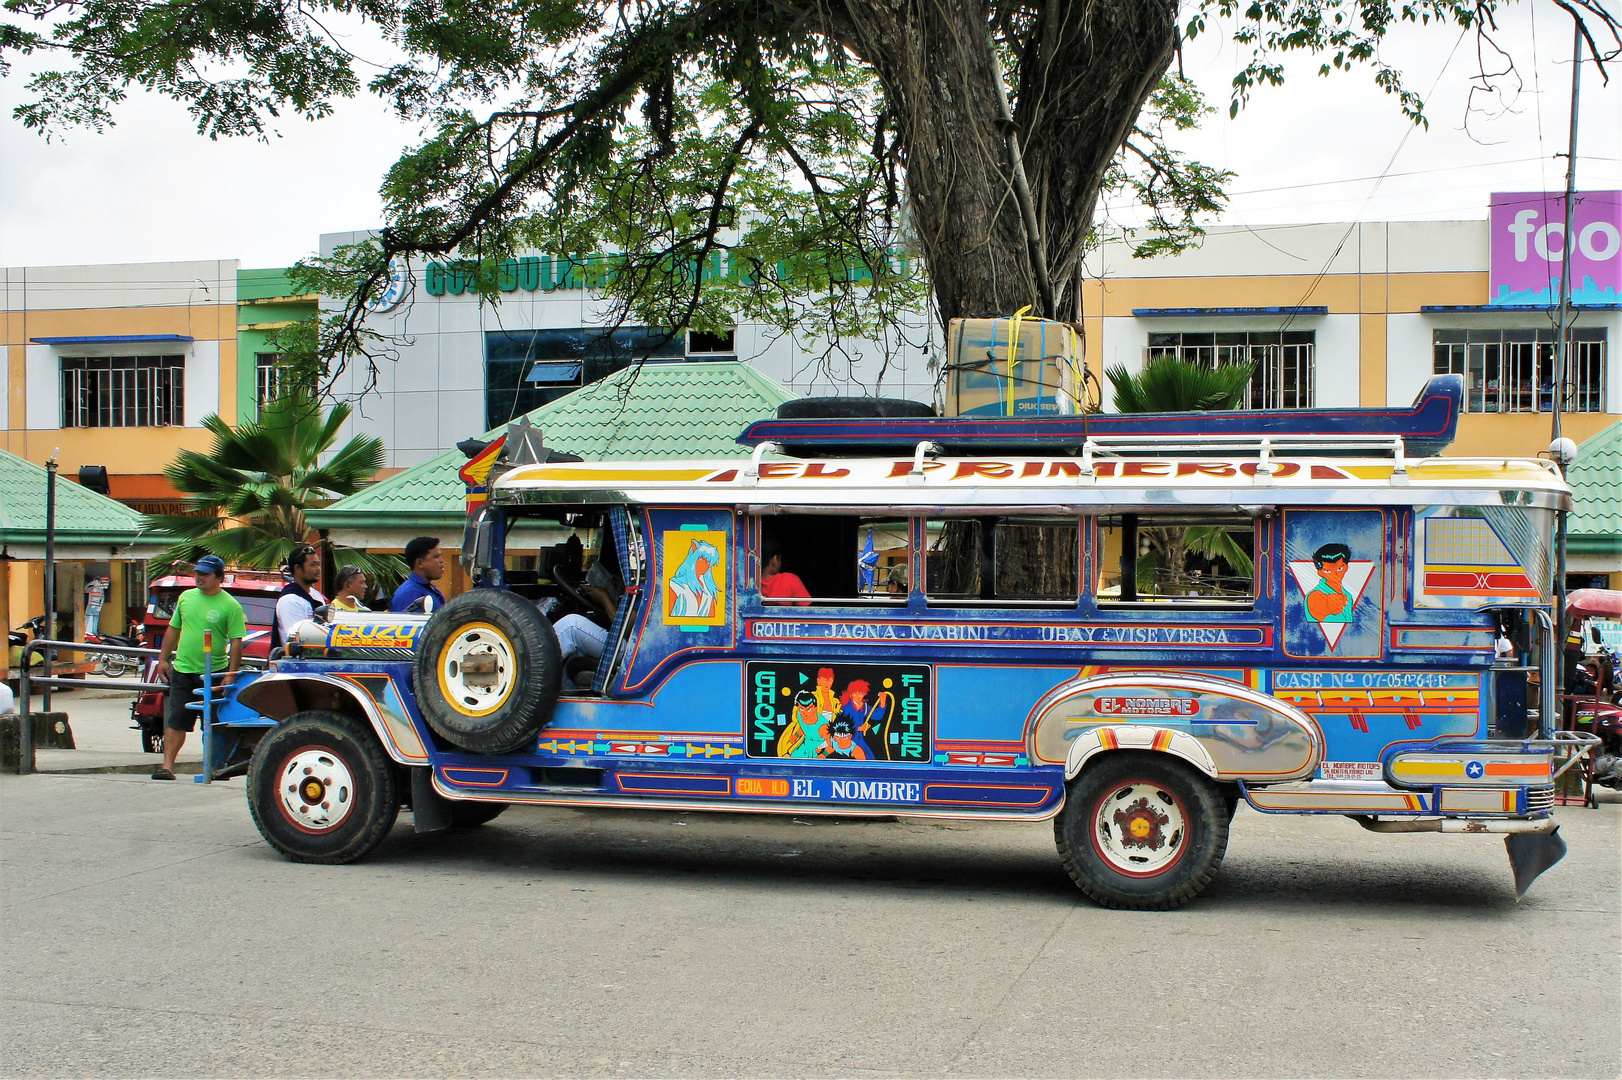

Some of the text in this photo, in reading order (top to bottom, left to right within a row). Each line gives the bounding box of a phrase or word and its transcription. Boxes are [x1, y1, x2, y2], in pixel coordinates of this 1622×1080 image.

[757, 461, 1301, 482] EL PRIMERO
[331, 624, 419, 647] ISUZU
[1041, 626, 1096, 642] UBAY
[1114, 627, 1159, 643] VISE
[1163, 628, 1229, 644] VERSA
[1276, 673, 1323, 688] CASE
[754, 670, 776, 753] GHOST
[901, 674, 923, 758] FIGHTER
[1101, 698, 1192, 714] EL NOMBRE
[792, 779, 920, 802] EL NOMBRE
